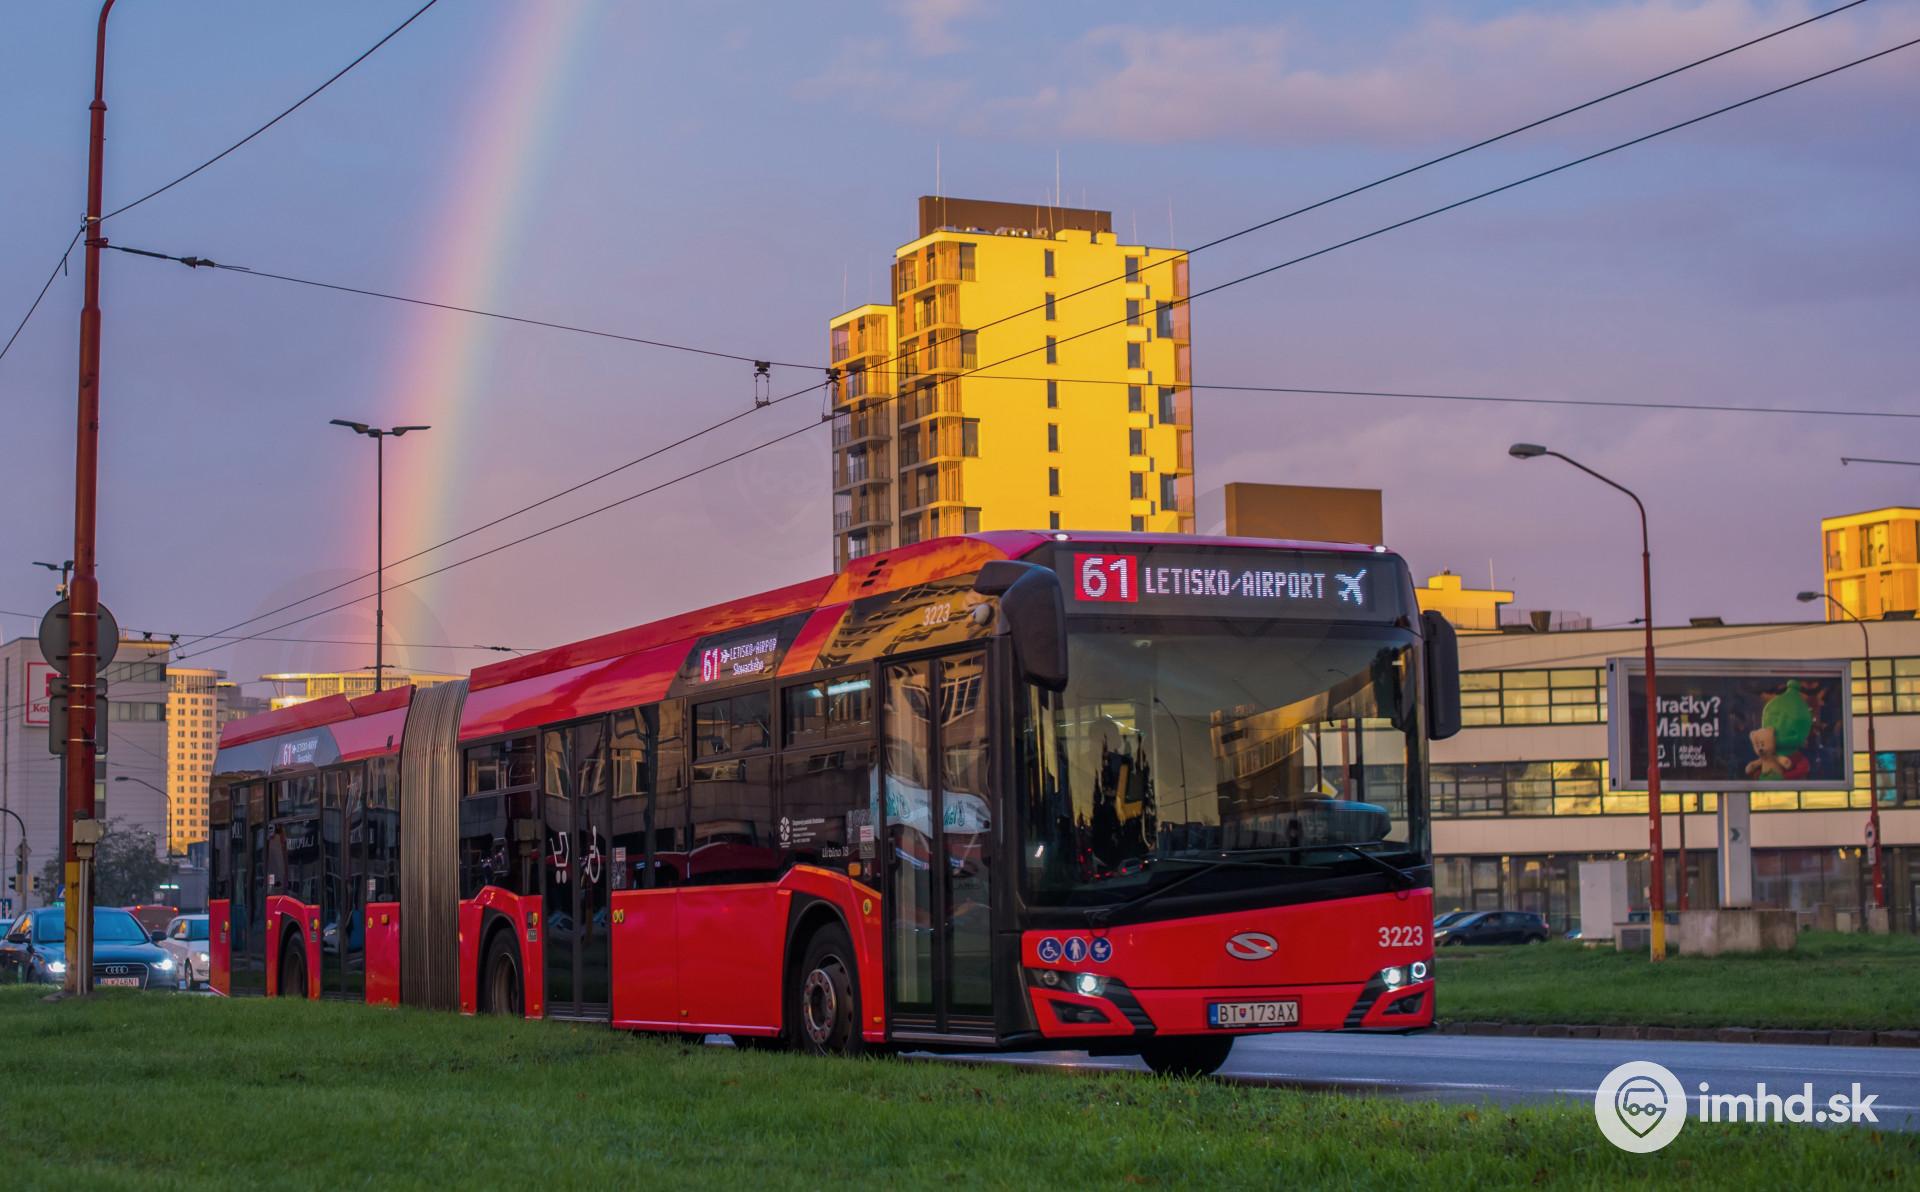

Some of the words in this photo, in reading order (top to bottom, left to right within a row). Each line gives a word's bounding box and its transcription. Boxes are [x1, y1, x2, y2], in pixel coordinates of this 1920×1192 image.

[1081, 556, 1128, 599] 61
[1144, 566, 1326, 599] LETISKO/AIRPORT
[923, 602, 951, 627] 3223
[703, 648, 719, 682] 61
[1378, 925, 1424, 948] 3223
